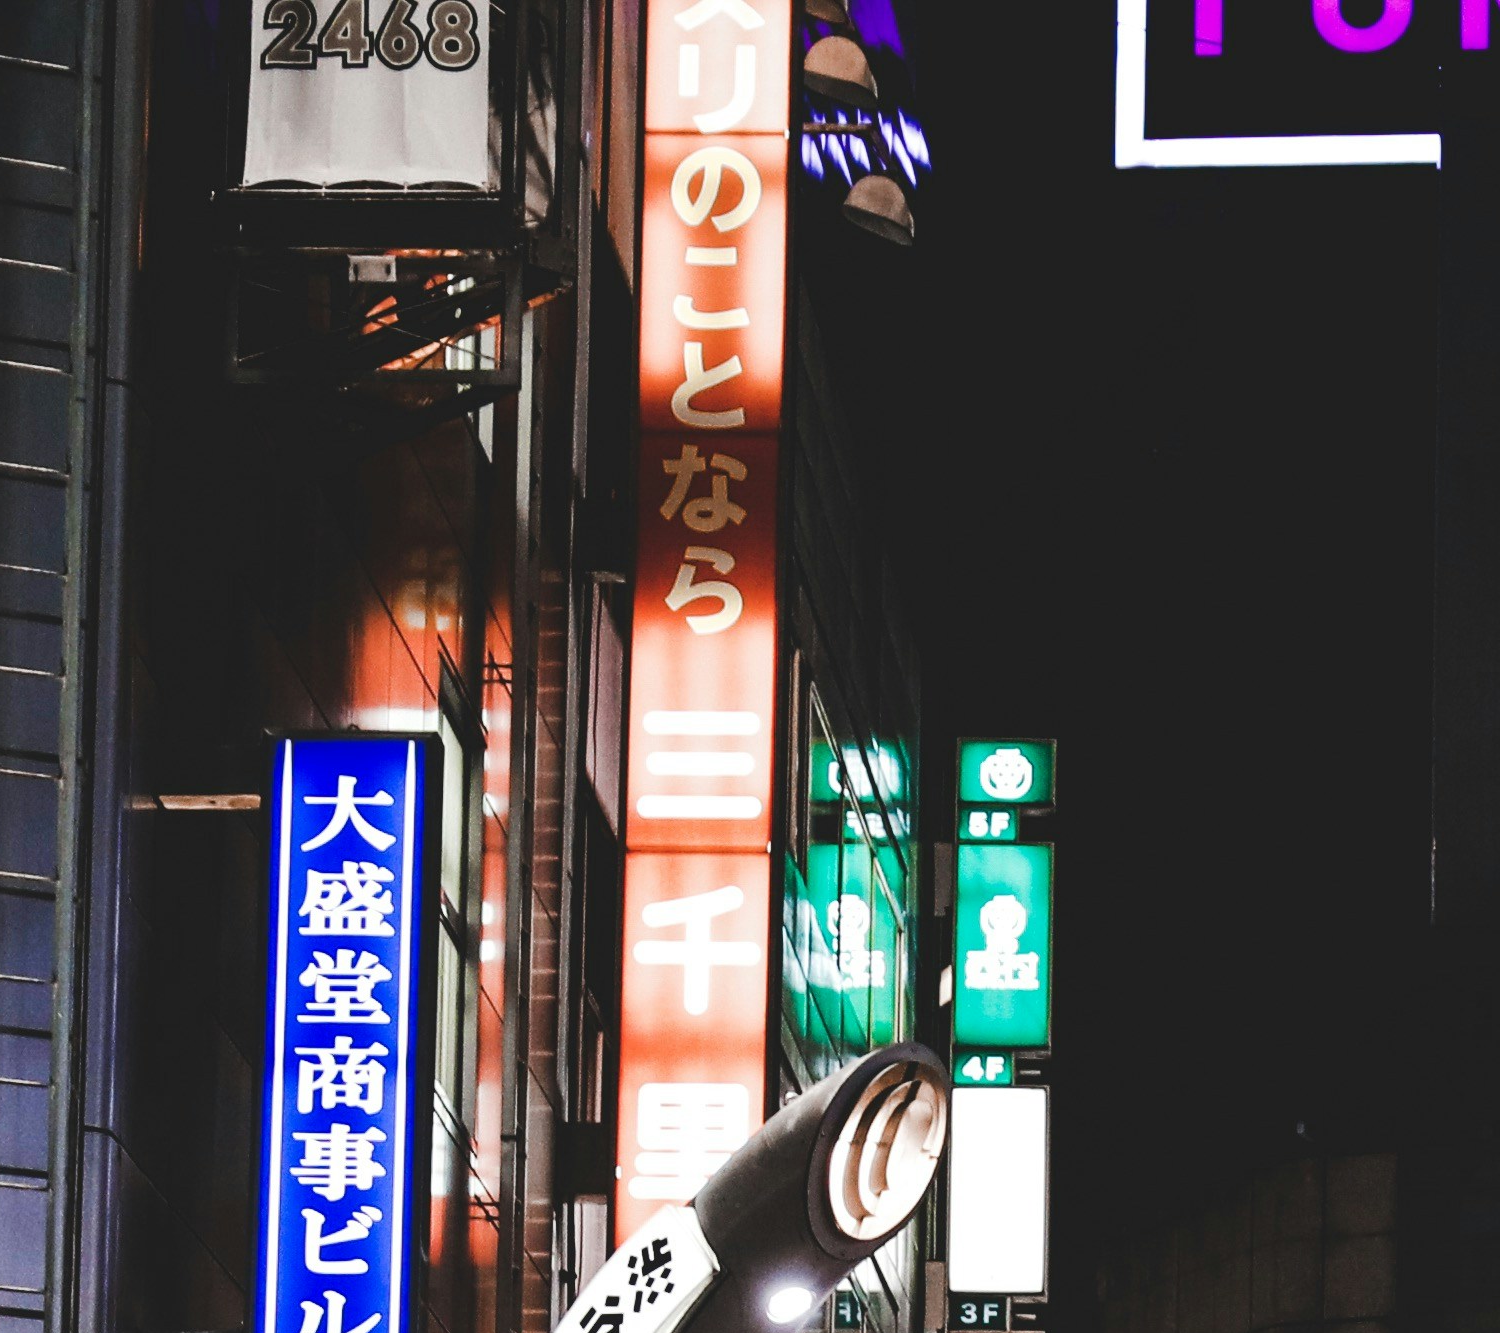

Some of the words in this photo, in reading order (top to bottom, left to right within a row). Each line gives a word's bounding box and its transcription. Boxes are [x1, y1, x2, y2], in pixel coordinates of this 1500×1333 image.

[260, 0, 480, 71] 2468
[968, 811, 1010, 838] 5F
[962, 1056, 1005, 1081] 4F
[960, 1303, 999, 1324] 3F
